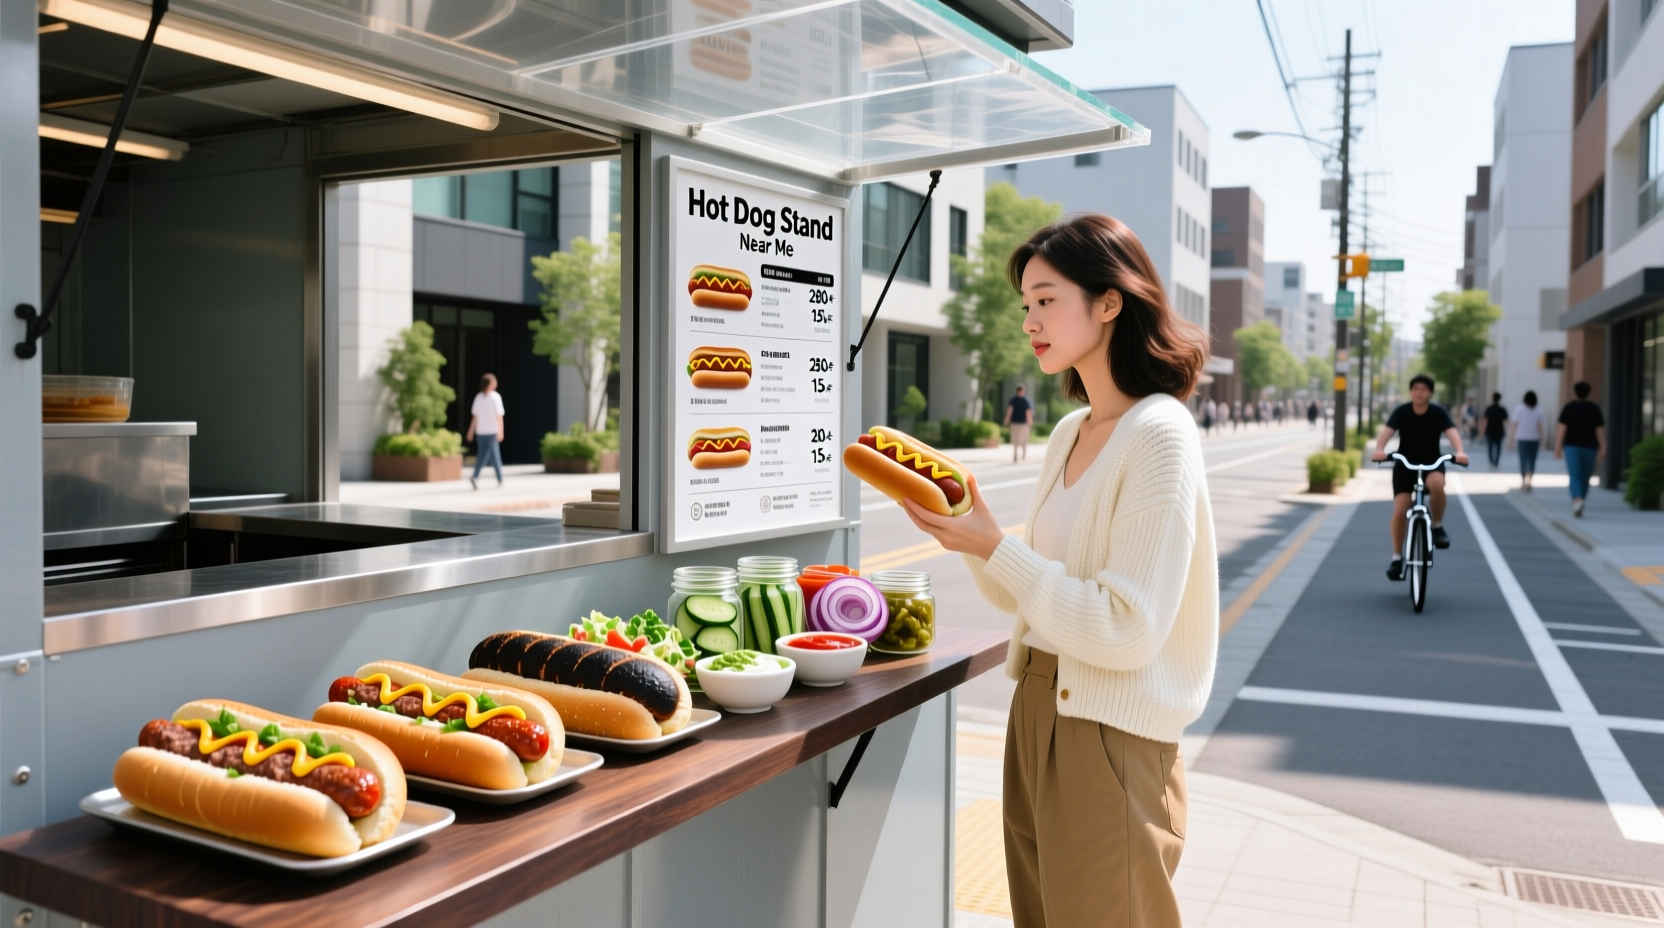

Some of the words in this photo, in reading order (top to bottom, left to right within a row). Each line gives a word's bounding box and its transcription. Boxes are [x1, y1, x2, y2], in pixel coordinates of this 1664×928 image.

[689, 187, 729, 222] Hot
[734, 196, 776, 236] Dog
[780, 206, 833, 241] Stand
[740, 232, 772, 254] Near
[775, 238, 794, 257] Me
